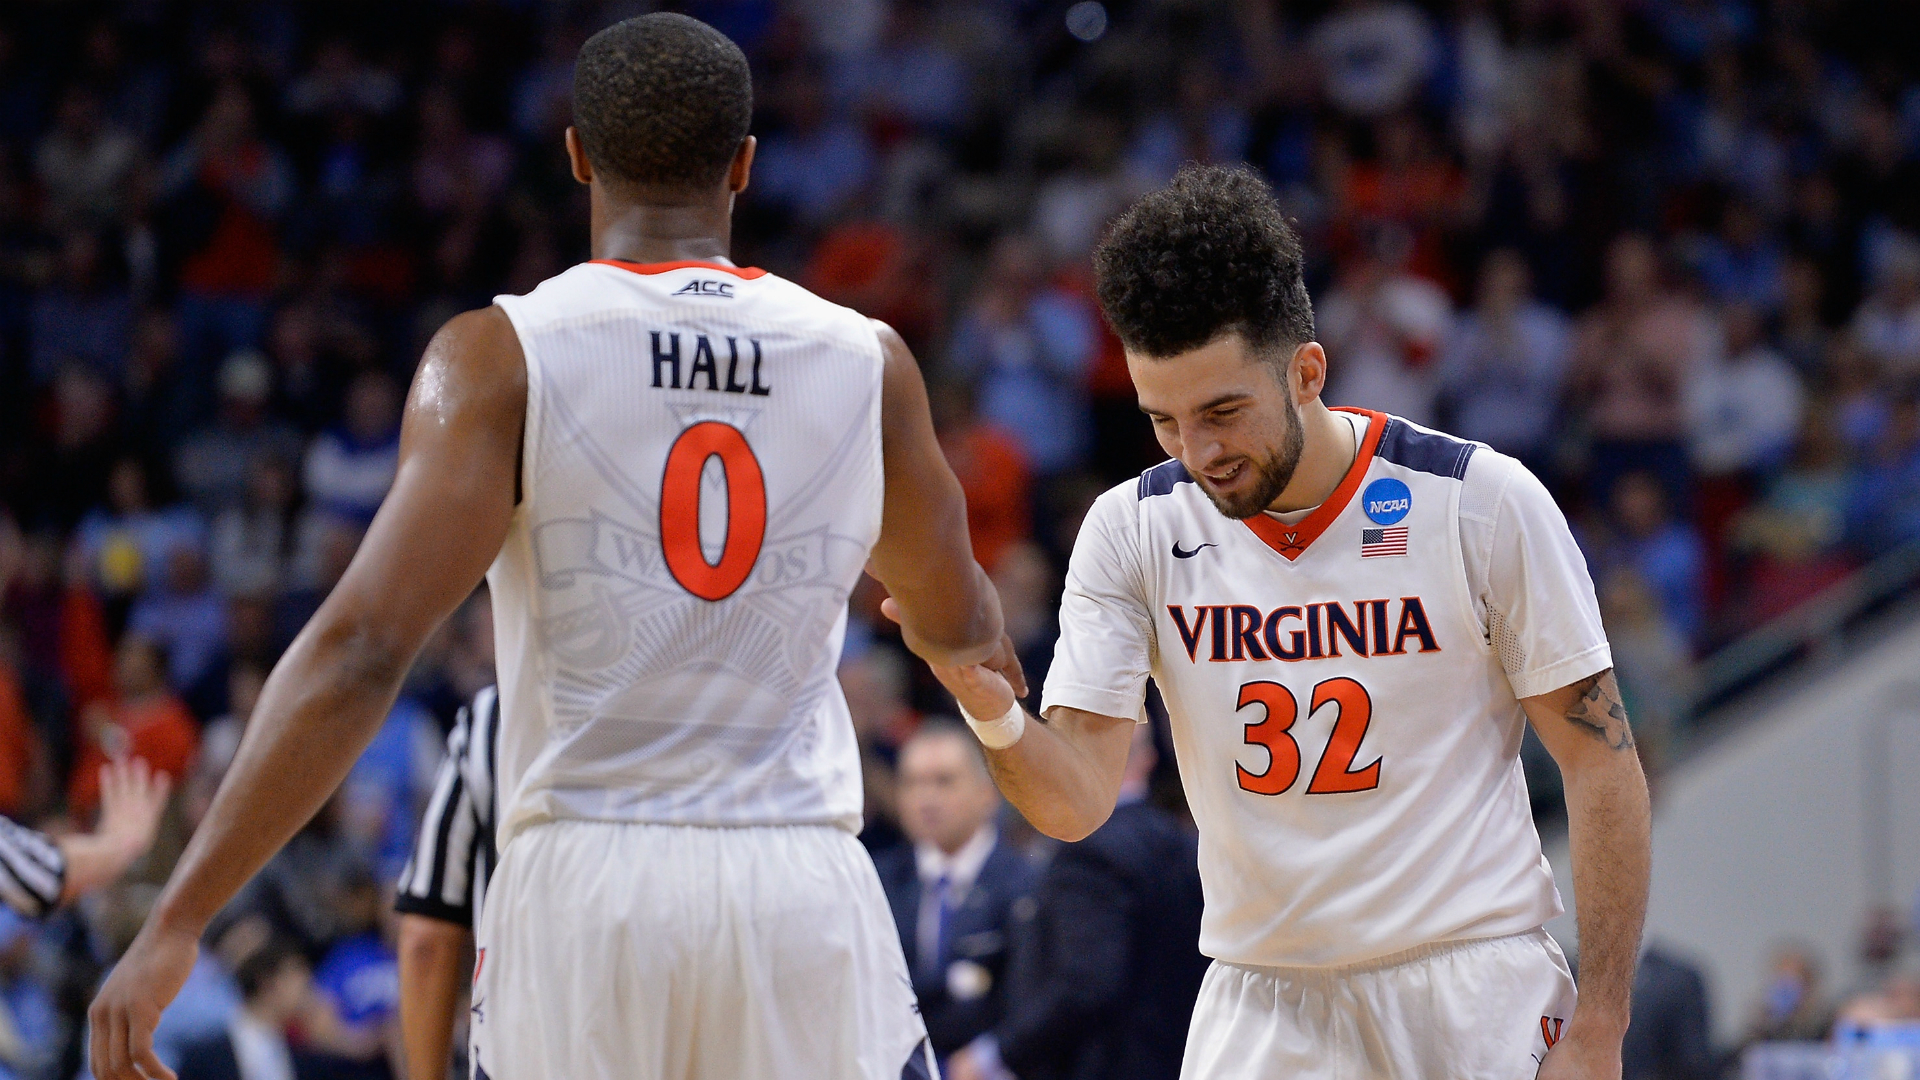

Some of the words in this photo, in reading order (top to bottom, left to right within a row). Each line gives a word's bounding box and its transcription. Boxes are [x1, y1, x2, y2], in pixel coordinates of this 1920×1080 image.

[673, 279, 734, 297] ACC
[650, 331, 771, 396] HALL
[660, 420, 768, 602] 0
[1370, 498, 1409, 514] NCAA
[1167, 596, 1442, 664] VIRGINIA
[1235, 677, 1383, 796] 32
